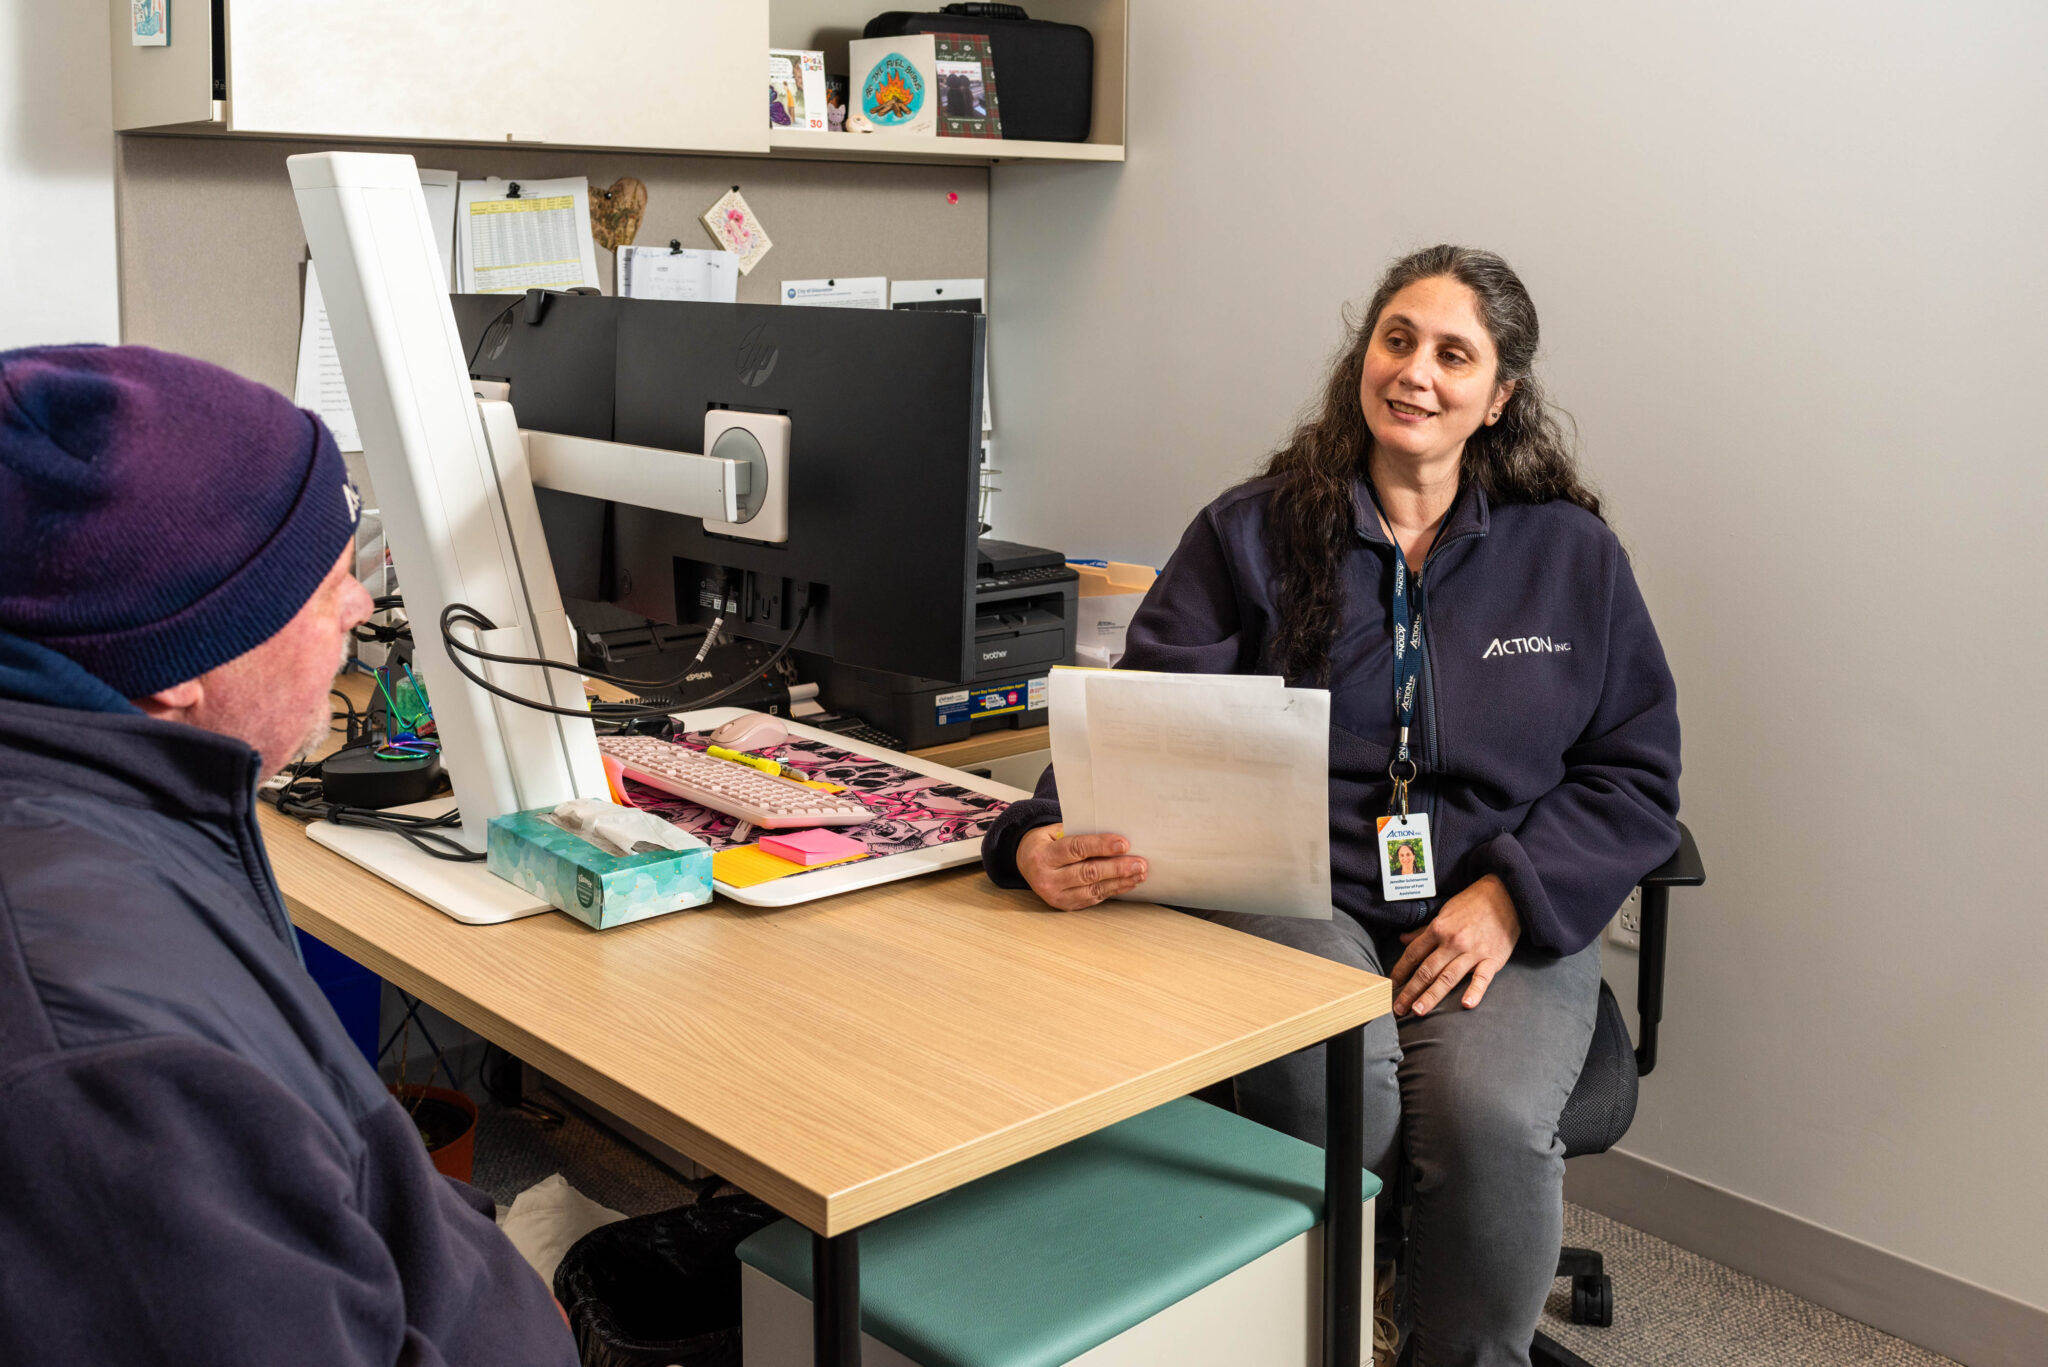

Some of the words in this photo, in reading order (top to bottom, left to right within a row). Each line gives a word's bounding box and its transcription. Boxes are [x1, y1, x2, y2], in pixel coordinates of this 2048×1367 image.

[886, 59, 904, 69] FUEL
[810, 119, 823, 128] 30
[1398, 622, 1406, 652] ACTION
[1410, 621, 1419, 649] ACTION
[1482, 636, 1552, 658] ACTION
[983, 650, 1007, 660] brother
[686, 671, 713, 681] EPSON
[1401, 682, 1412, 712] ACTION
[1387, 829, 1415, 838] ACTION
